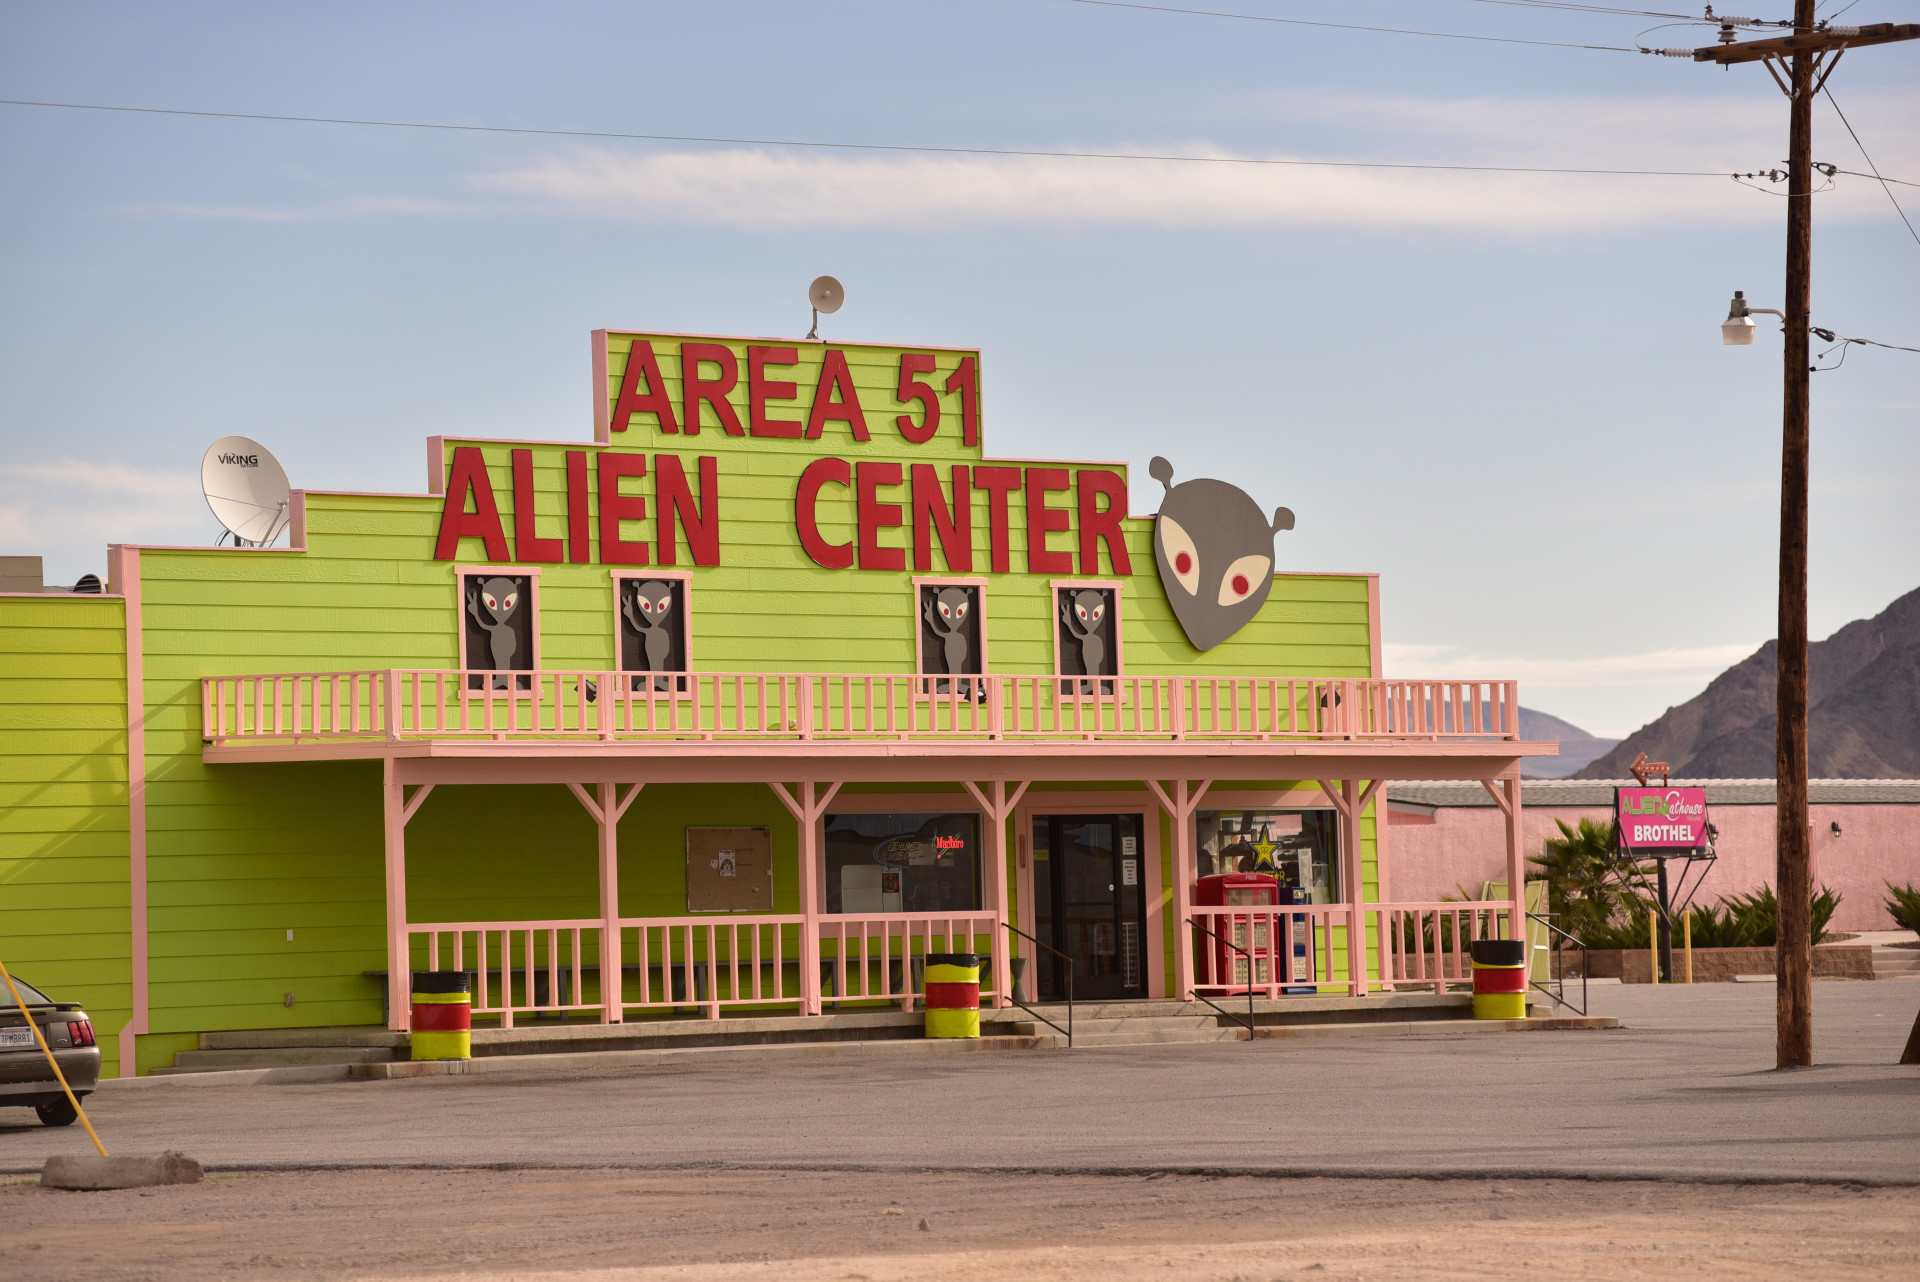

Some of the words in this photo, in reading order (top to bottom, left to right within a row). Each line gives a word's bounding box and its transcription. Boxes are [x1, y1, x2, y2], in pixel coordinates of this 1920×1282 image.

[610, 339, 871, 442] AREA
[895, 352, 979, 448] 51
[218, 453, 258, 464] VIKING
[433, 445, 721, 567] ALIEN
[794, 456, 1133, 576] CENTER
[1622, 796, 1669, 817] ALIEN
[1665, 791, 1704, 821] Cathouse
[936, 835, 965, 849] Marlboro
[1633, 824, 1695, 842] BROTHEL
